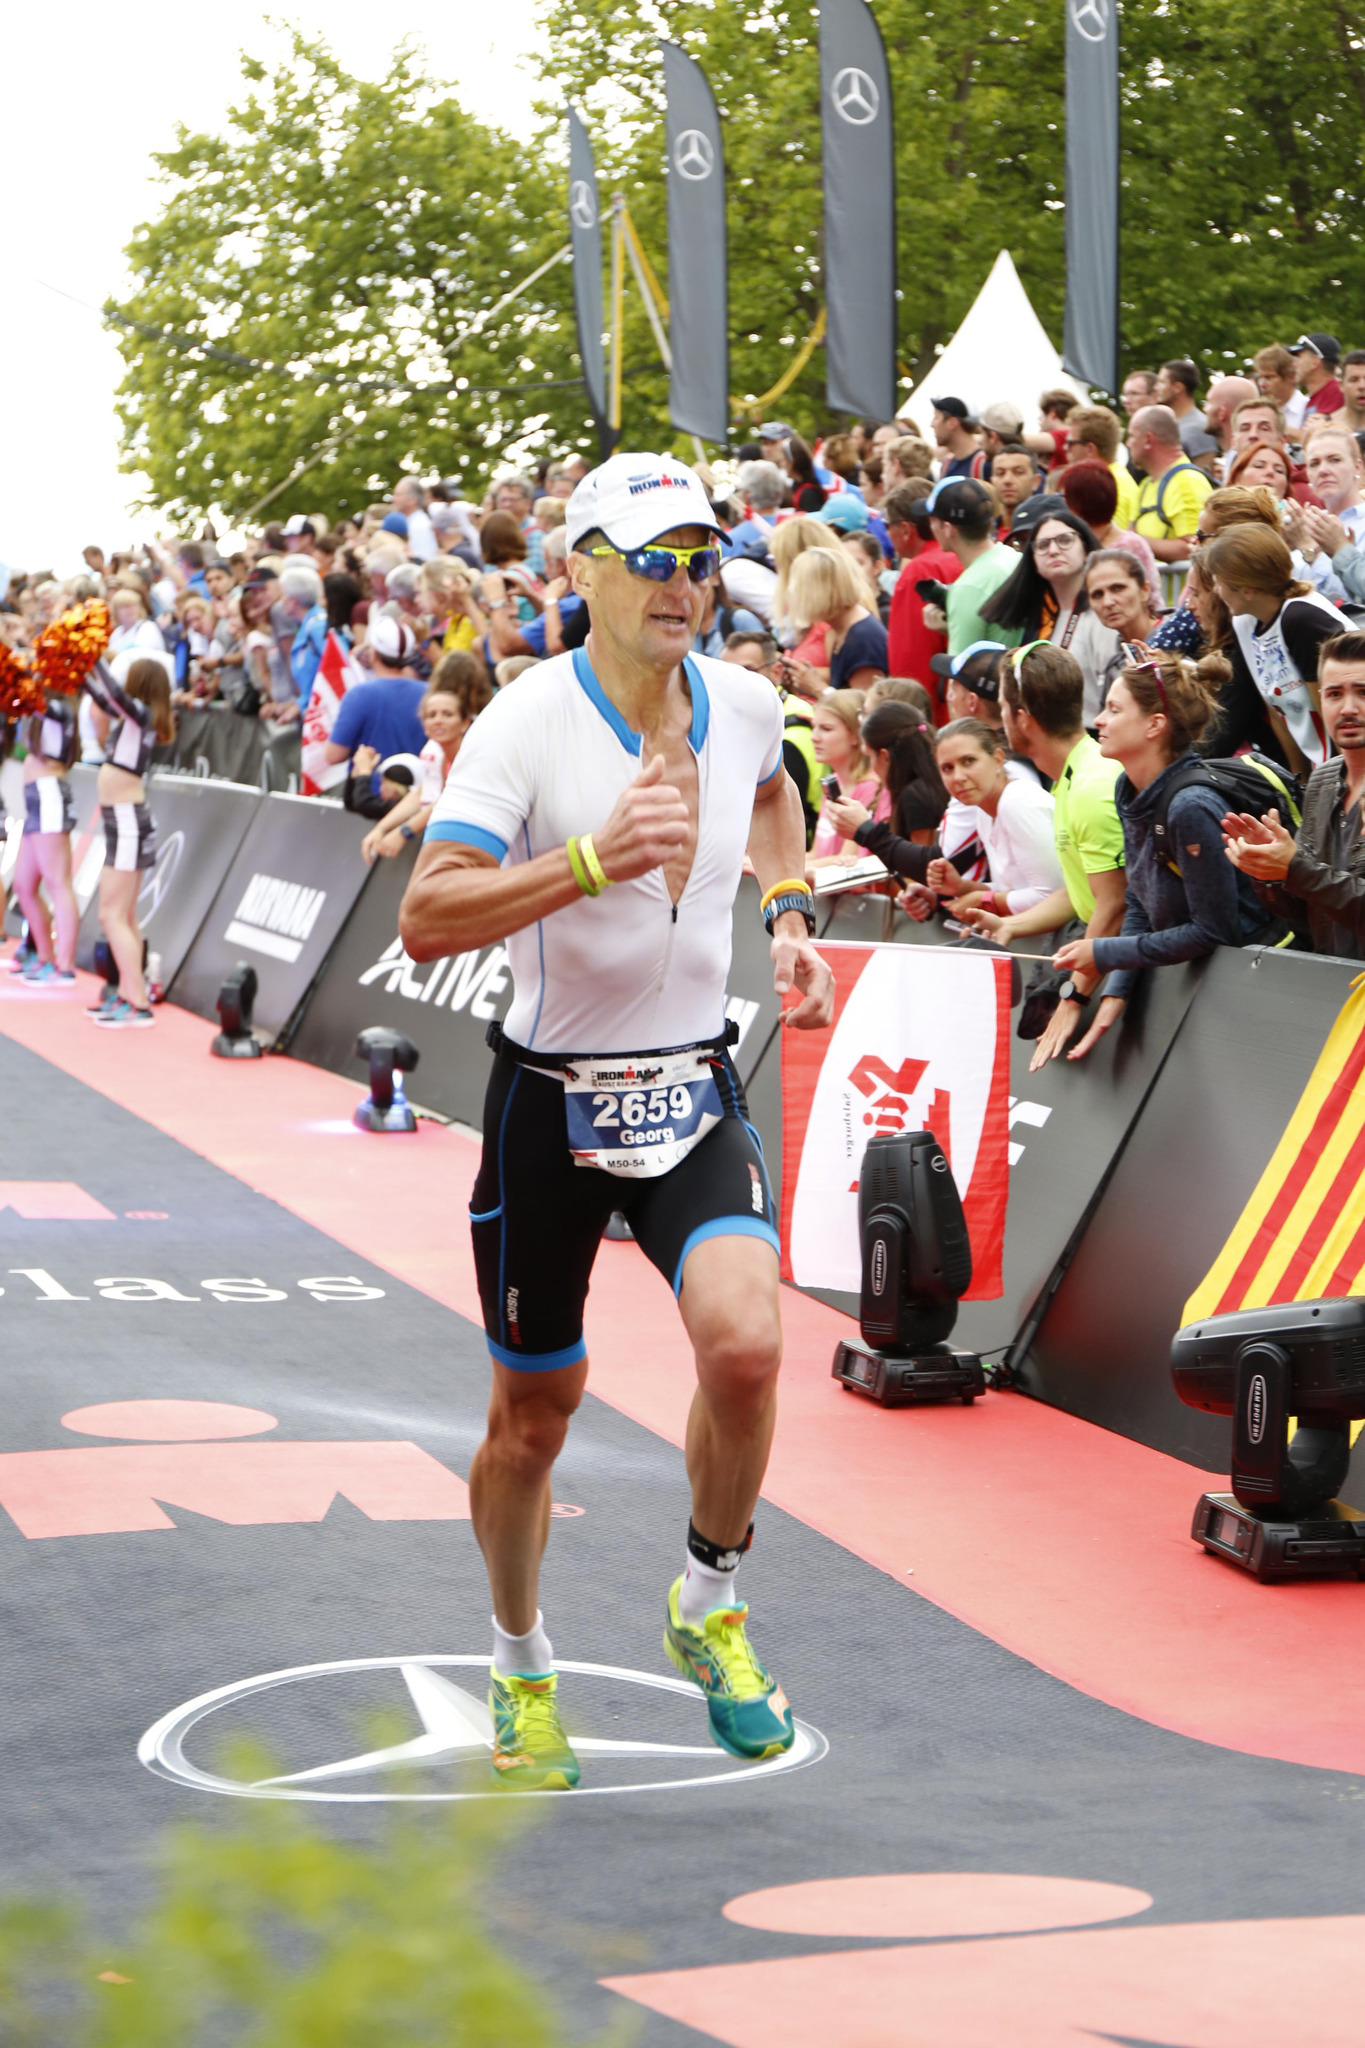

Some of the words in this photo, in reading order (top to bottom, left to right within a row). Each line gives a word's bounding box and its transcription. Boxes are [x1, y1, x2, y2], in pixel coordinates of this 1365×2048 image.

[629, 474, 689, 495] IRONMAN
[592, 1085, 693, 1127] 2659
[620, 1127, 676, 1145] Georg
[607, 1159, 646, 1168] M50-54
[0, 1268, 386, 1302] lass
[1253, 1403, 1261, 1423] SPOT
